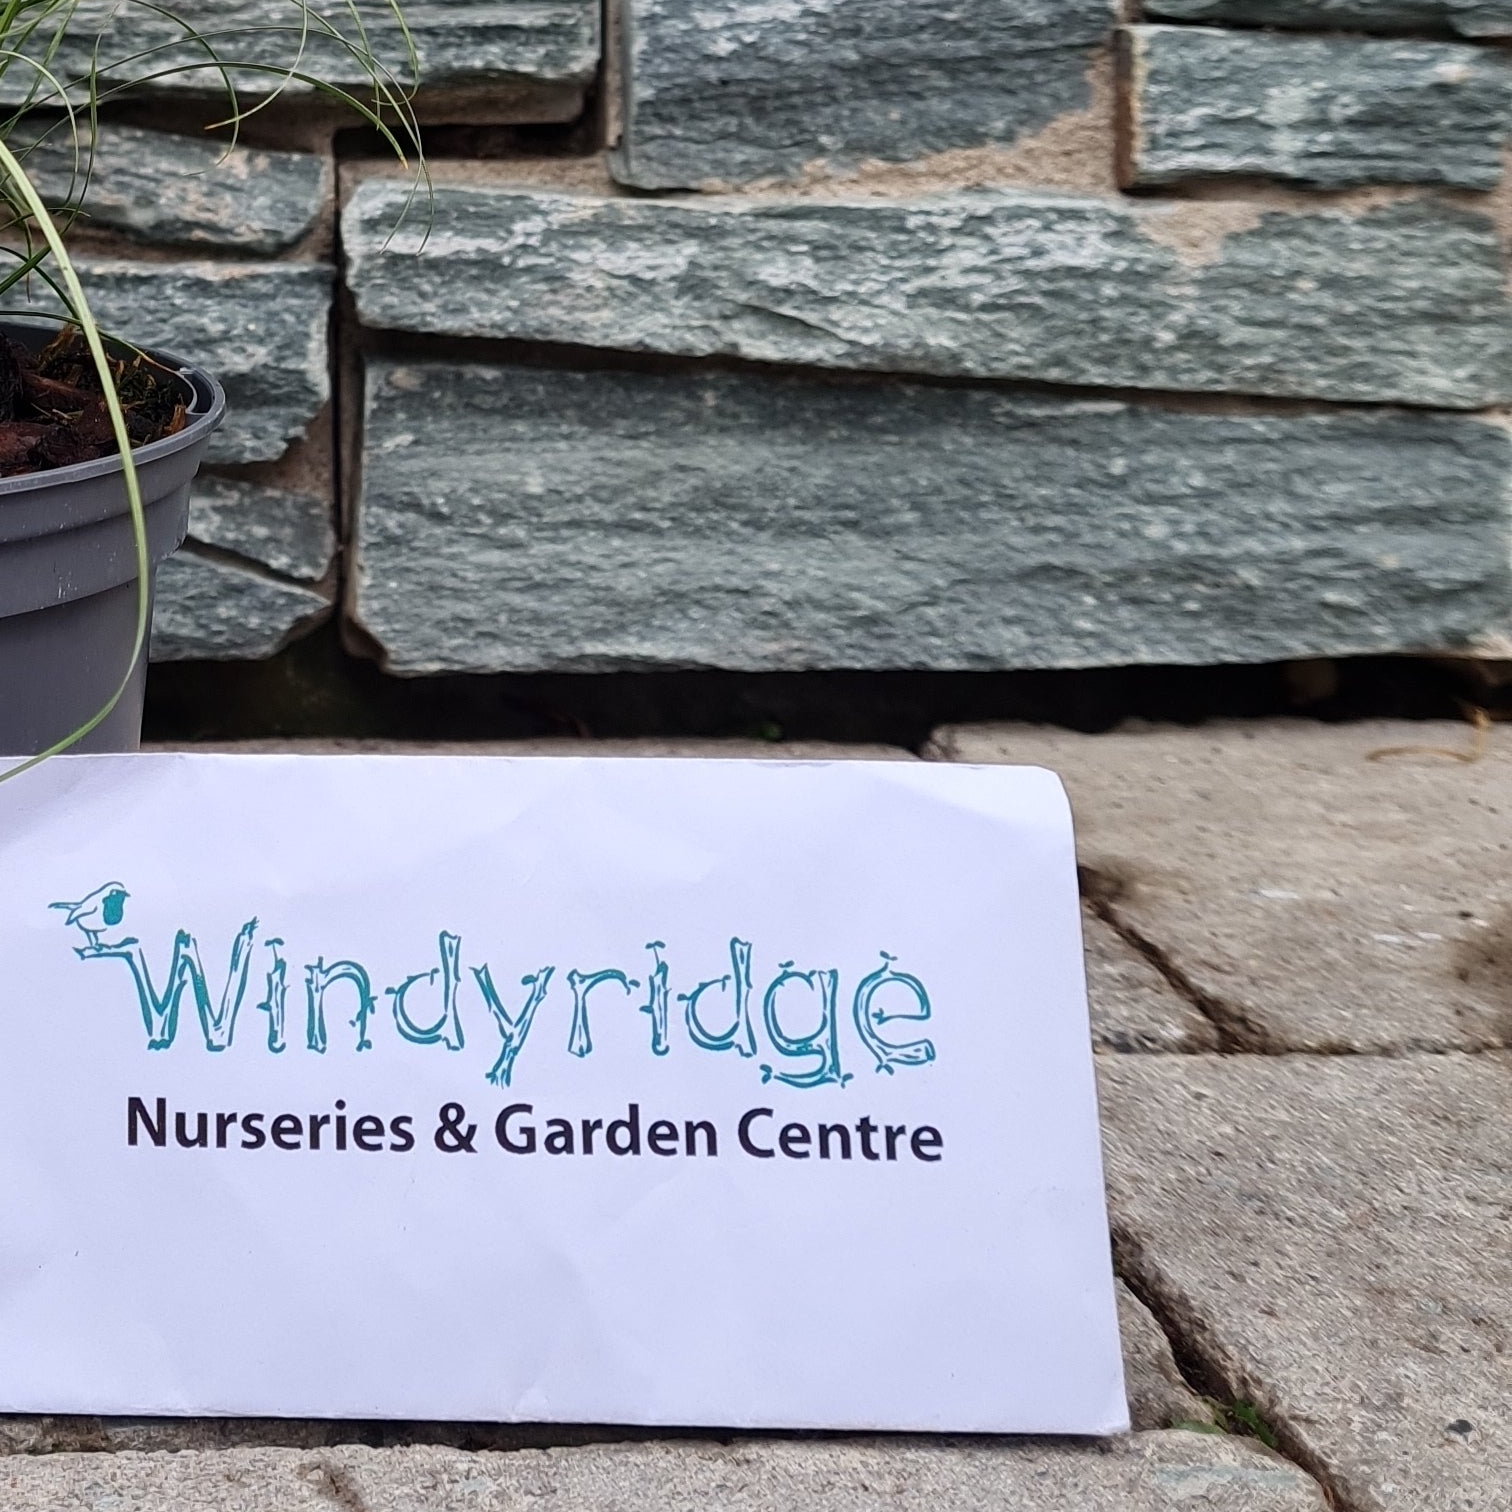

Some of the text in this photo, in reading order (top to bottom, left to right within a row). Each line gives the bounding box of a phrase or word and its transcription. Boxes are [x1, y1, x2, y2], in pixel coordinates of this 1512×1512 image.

[73, 917, 937, 1089] Windyridge
[127, 1095, 945, 1164] Nurseries & Garden Centre
